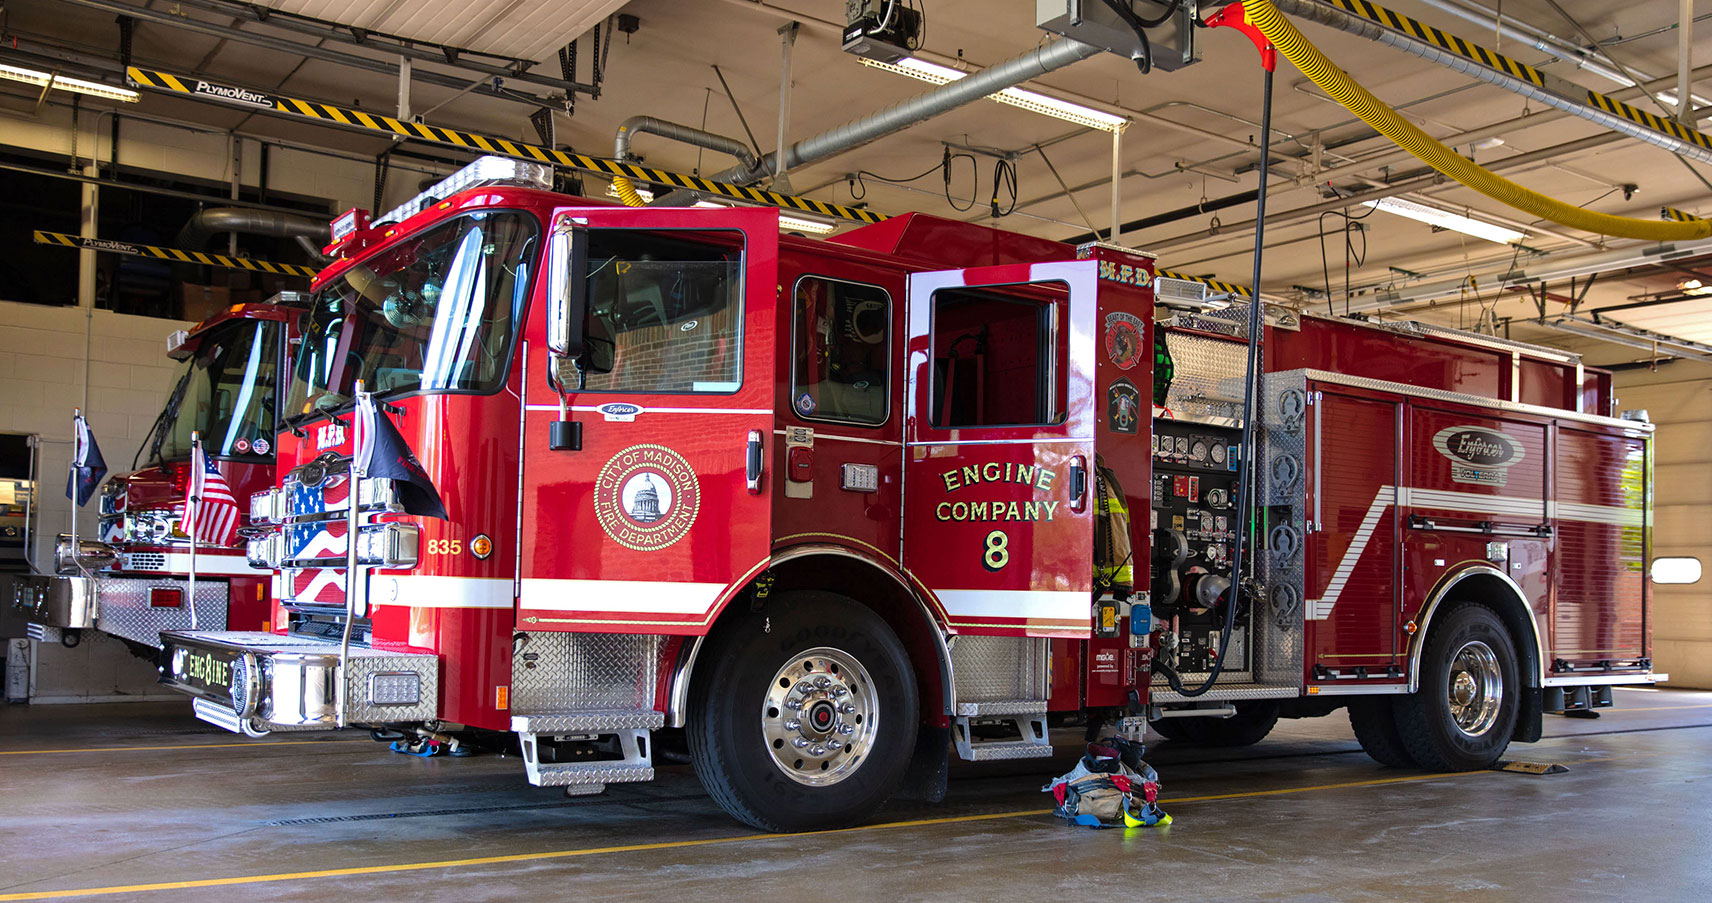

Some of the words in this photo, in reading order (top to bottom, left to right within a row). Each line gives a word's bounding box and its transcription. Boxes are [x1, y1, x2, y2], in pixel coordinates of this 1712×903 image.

[1099, 260, 1153, 288] M.F.D.
[1458, 434, 1504, 460] Enforcer
[602, 461, 621, 489] CITY
[622, 450, 640, 466] OF
[643, 450, 693, 491] MADISON
[941, 462, 1056, 493] ENGINE
[600, 501, 620, 531] FIRE
[619, 503, 693, 545] DEPARTMENT
[935, 501, 1059, 521] COMPANY
[427, 539, 462, 555] 835
[981, 530, 1009, 572] 8
